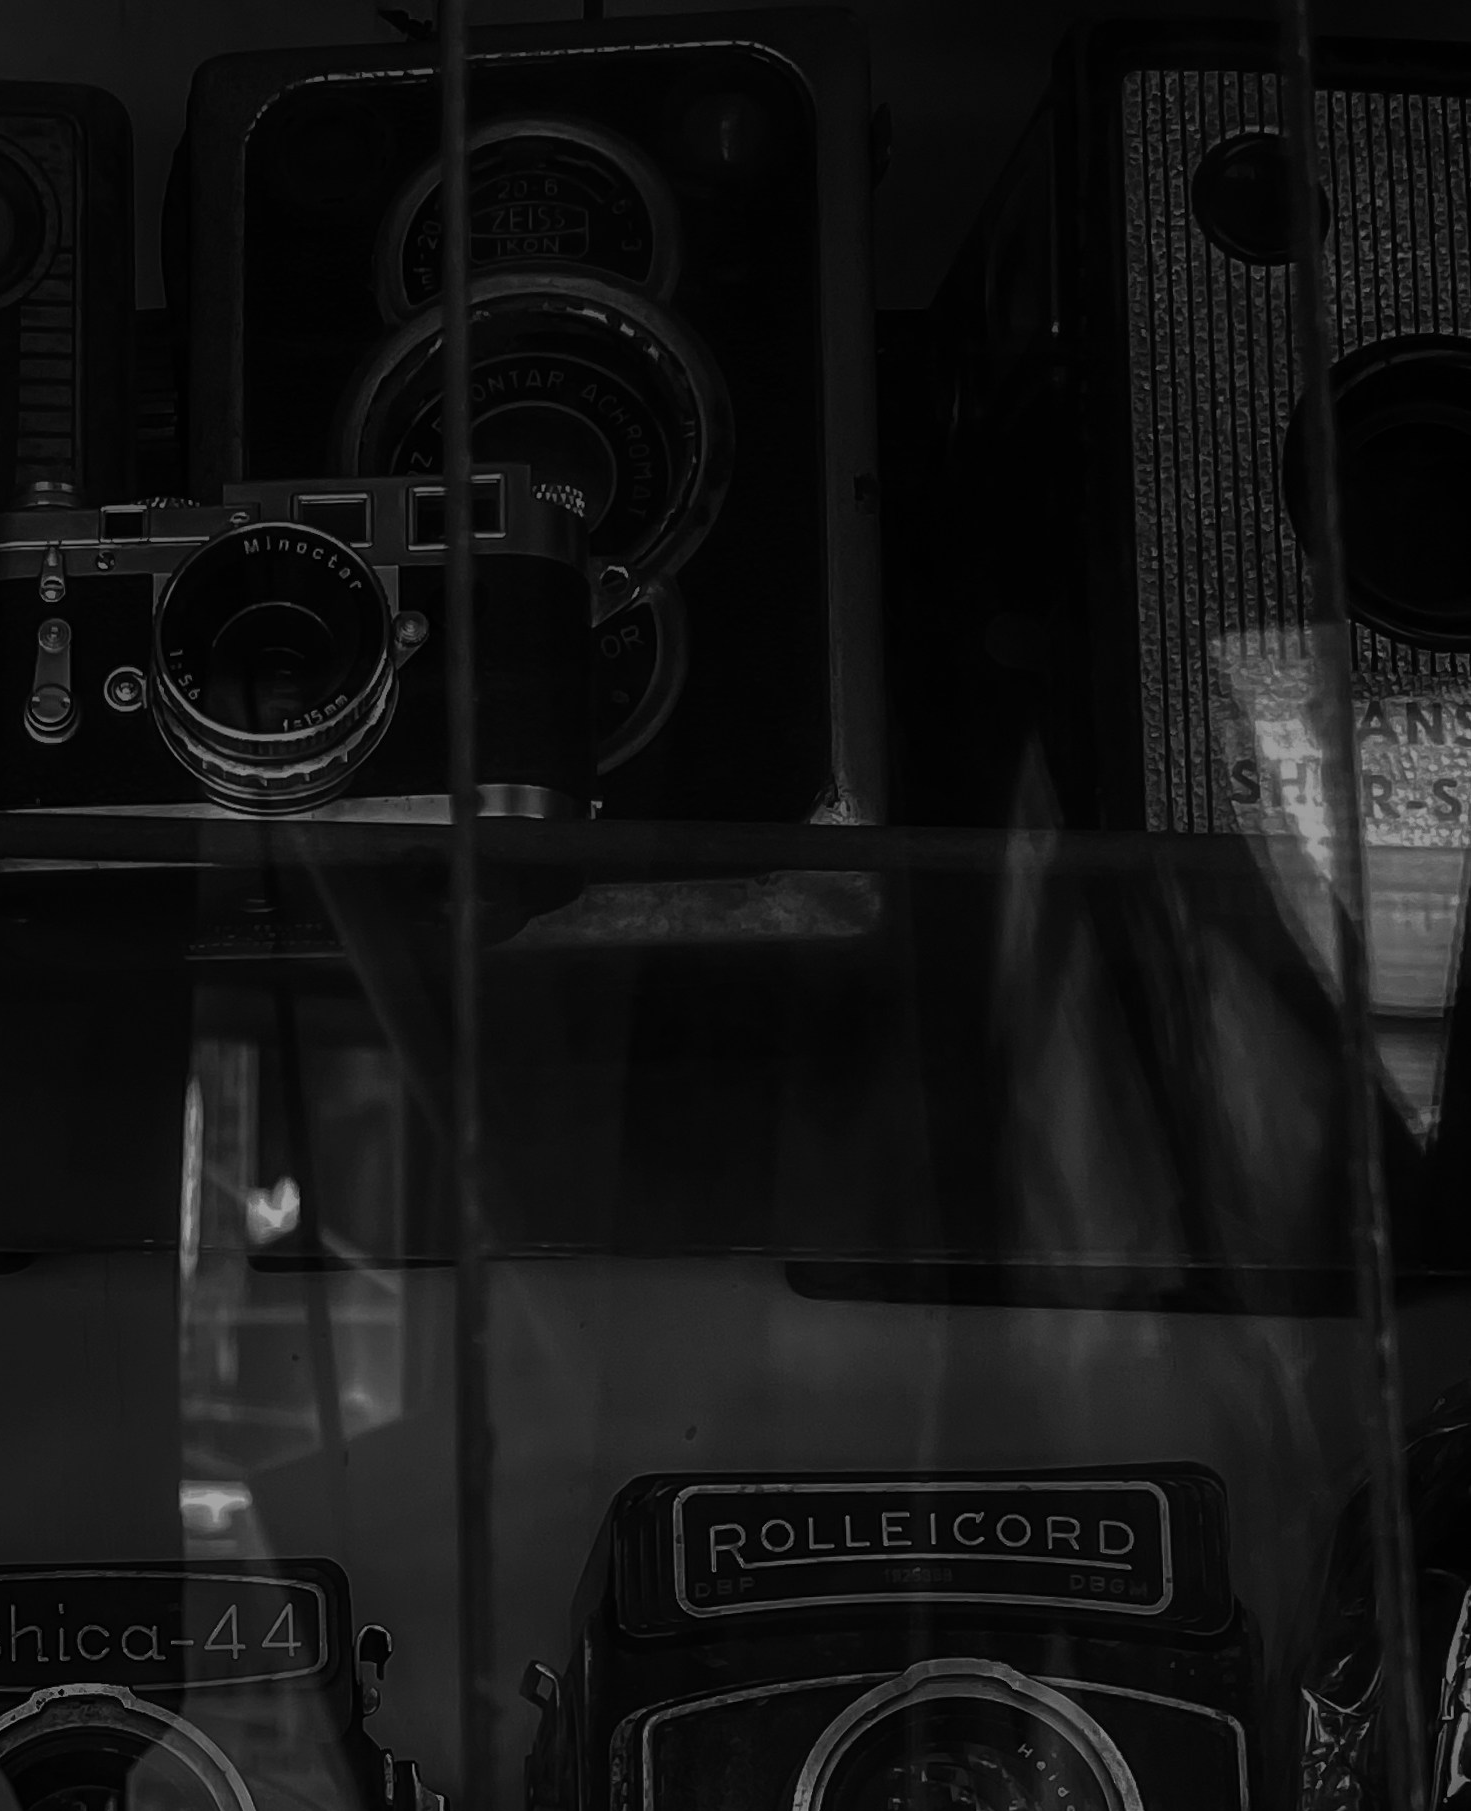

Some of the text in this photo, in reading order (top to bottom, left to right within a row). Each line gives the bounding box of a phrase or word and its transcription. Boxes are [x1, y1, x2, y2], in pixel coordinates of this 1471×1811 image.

[497, 178, 559, 200] 20-6
[490, 206, 566, 233] ZEISS
[496, 235, 560, 257] IKON
[430, 368, 652, 520] FONTAR ACHROMAT
[709, 1511, 1135, 1572] ROLLEICORD
[694, 1576, 756, 1599] DBP
[1069, 1574, 1148, 1598] DBGM
